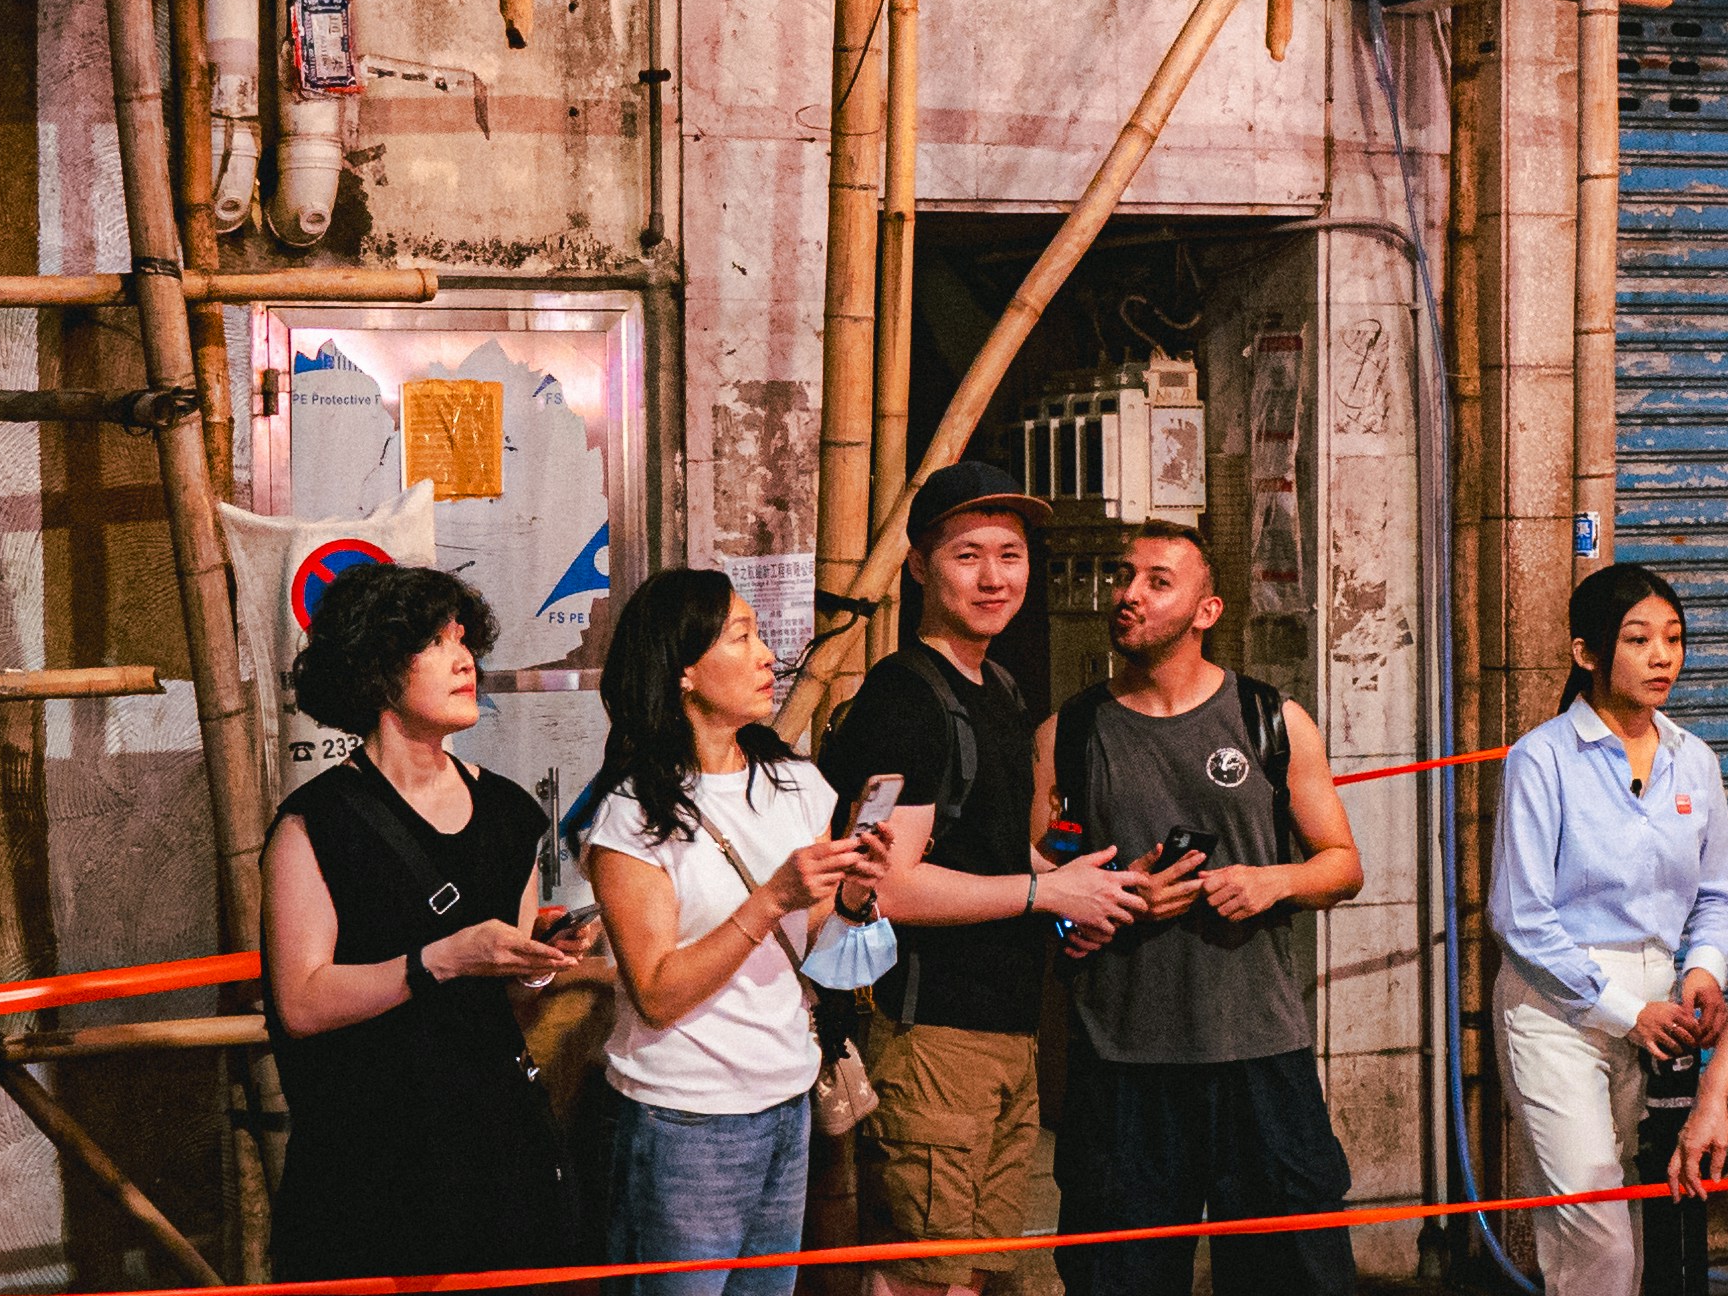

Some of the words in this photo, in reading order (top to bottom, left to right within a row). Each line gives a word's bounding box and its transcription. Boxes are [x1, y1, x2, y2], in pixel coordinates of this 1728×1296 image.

[311, 393, 371, 406] Protective
[546, 392, 563, 405] FS
[549, 611, 565, 624] FS
[569, 612, 585, 624] PE
